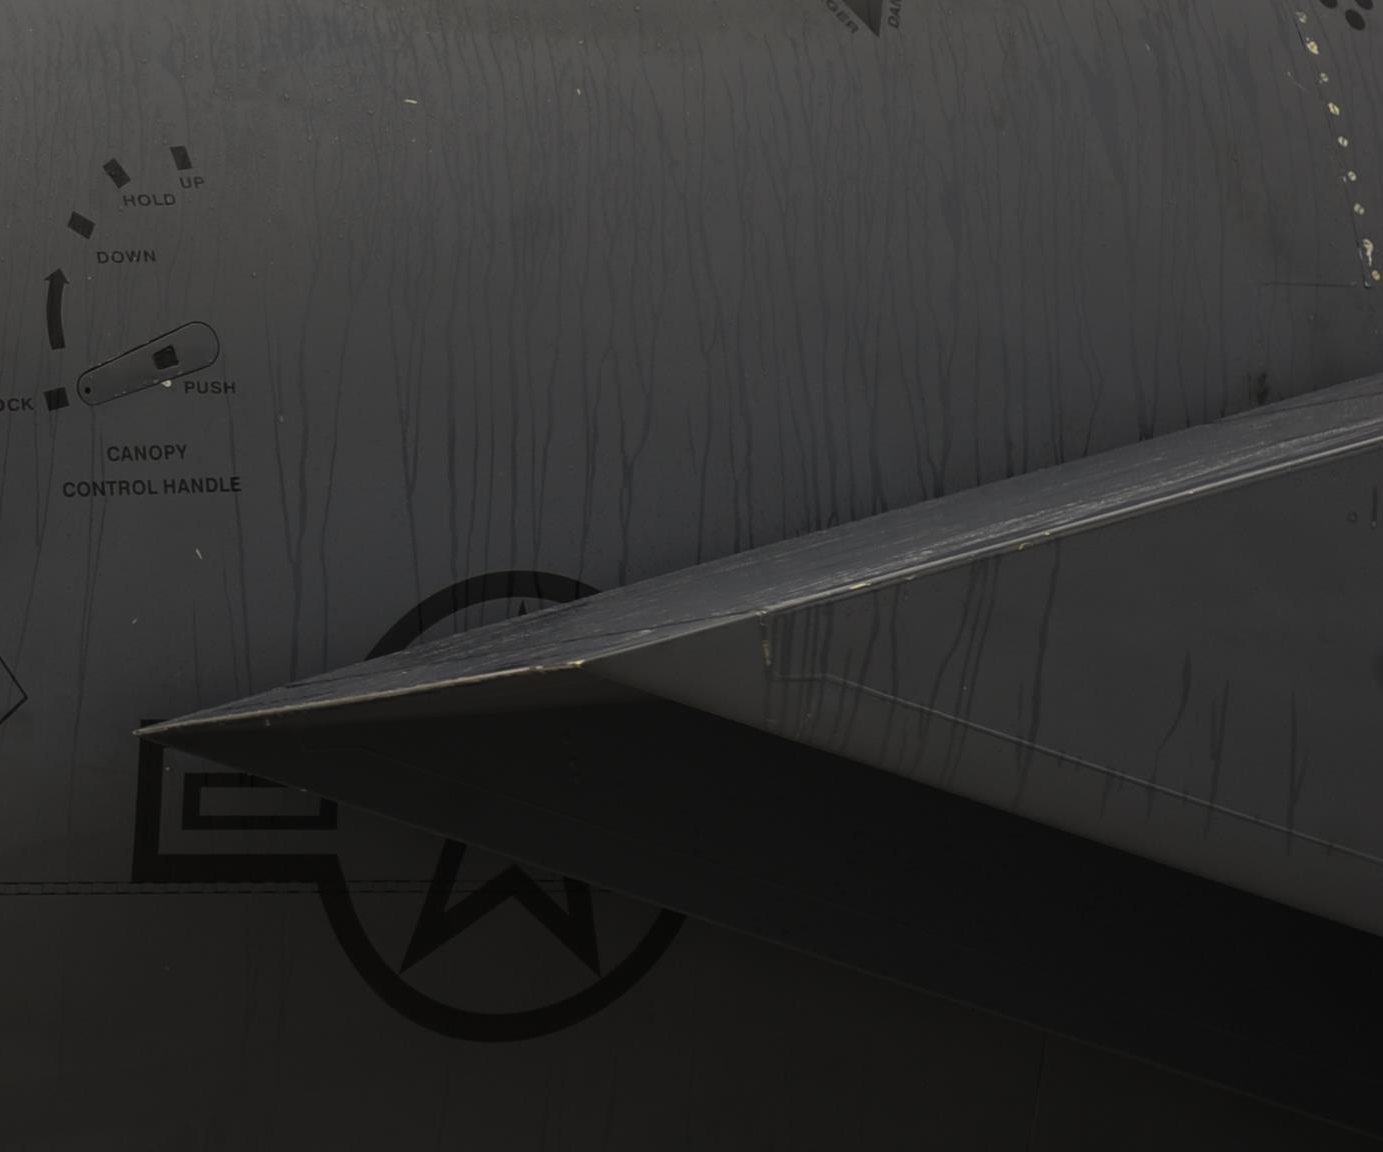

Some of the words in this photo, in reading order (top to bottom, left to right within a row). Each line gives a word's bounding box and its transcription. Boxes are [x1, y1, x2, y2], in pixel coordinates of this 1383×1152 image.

[179, 176, 205, 190] UP
[122, 193, 176, 207] HOLD
[96, 250, 157, 265] DOWN
[184, 380, 236, 395] PUSH
[106, 444, 188, 462] CANOPY
[62, 479, 157, 498] CONTROL
[162, 476, 243, 495] HANDLE
